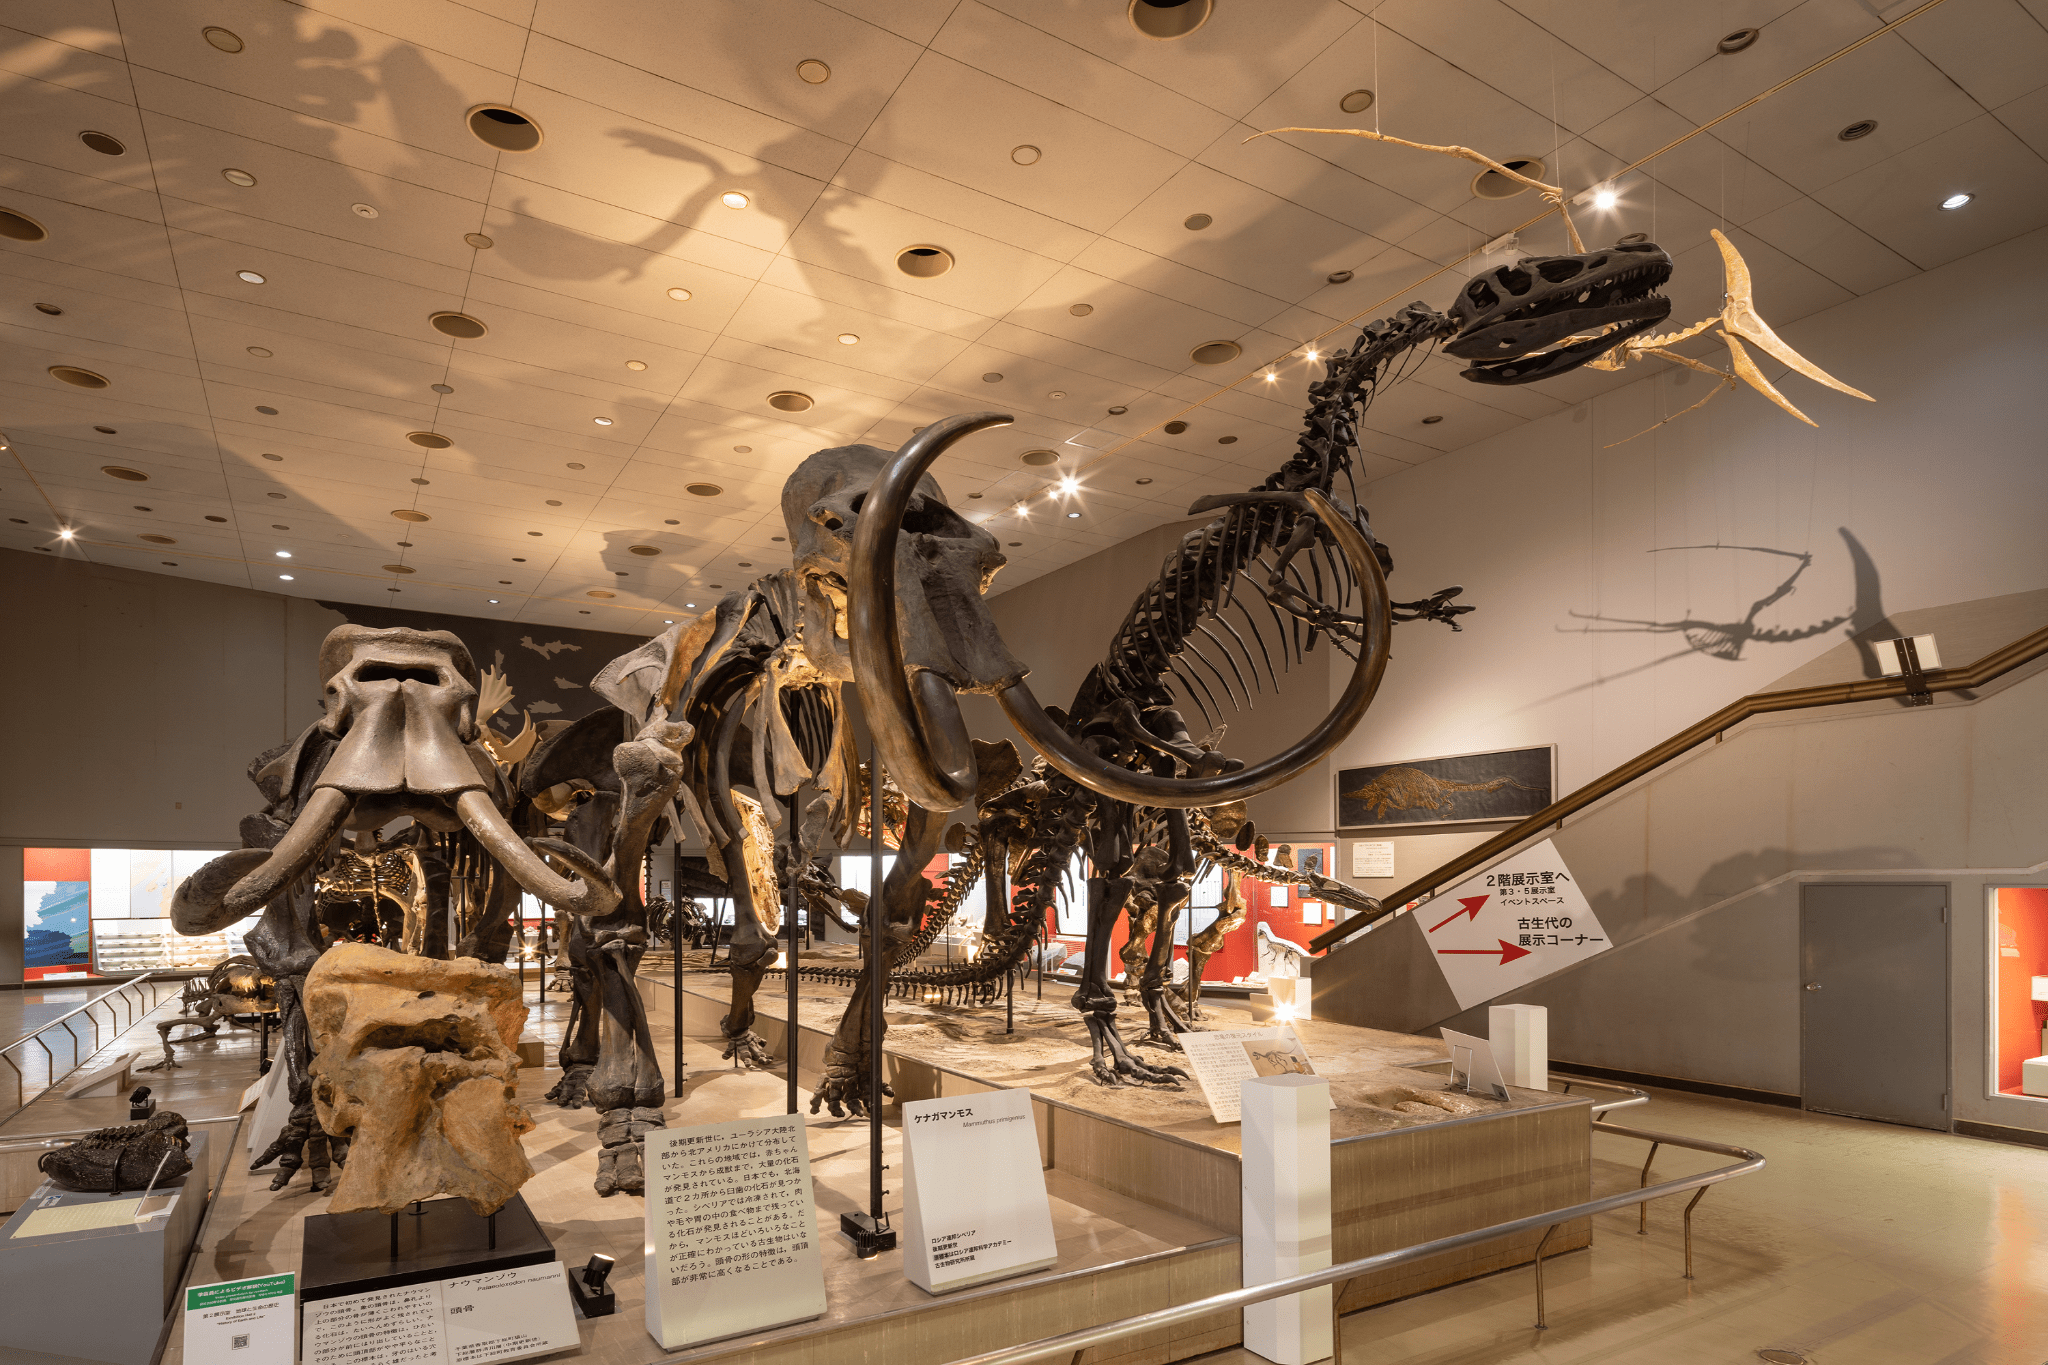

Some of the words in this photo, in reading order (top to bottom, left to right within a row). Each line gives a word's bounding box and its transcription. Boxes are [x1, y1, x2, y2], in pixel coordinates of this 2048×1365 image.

[1486, 870, 1570, 888] 2階展示室へ
[1499, 886, 1556, 896] 第3・5展示室
[1500, 897, 1565, 906] イベントスペース
[1517, 917, 1573, 930] 古生代の
[1518, 933, 1604, 947] 展示コーナー
[914, 1108, 974, 1124] ケナガマンモス
[963, 1118, 996, 1128] Mammuthus
[997, 1114, 1026, 1124] primigenius
[448, 1271, 517, 1289] ナウマンゾウ
[477, 1279, 526, 1292] Palaeoloxodon
[527, 1273, 561, 1283] naumanni
[450, 1304, 475, 1315] 頭骨
